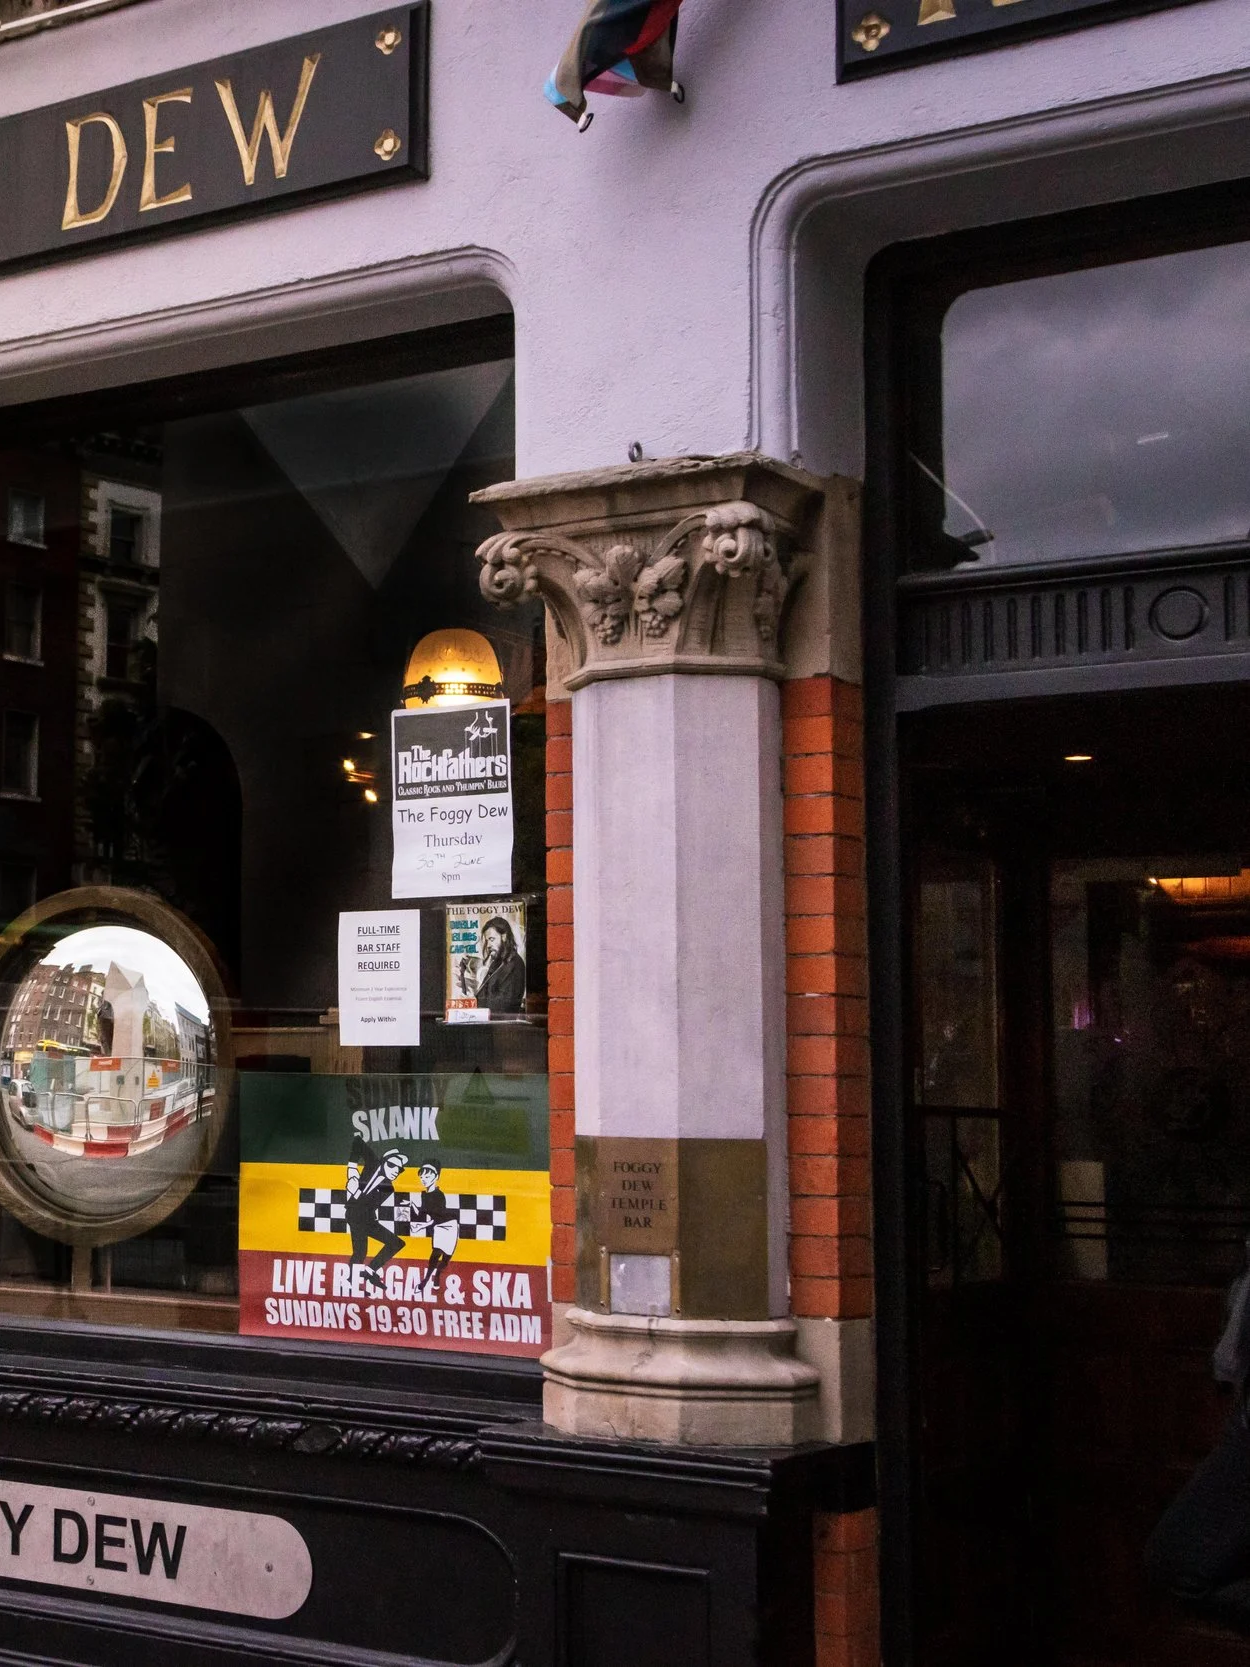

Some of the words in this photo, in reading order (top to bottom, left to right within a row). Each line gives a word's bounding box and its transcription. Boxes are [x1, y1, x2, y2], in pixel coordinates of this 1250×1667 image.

[60, 52, 321, 231] DEW
[411, 745, 431, 762] The
[397, 808, 425, 823] The
[430, 806, 473, 825] Foggy
[478, 803, 508, 819] Dew
[423, 832, 483, 848] Thursday
[441, 872, 461, 883] 8pm
[446, 907, 465, 916] THE
[467, 906, 499, 915] FOGGY
[502, 905, 523, 914] DEW
[357, 925, 400, 935] FULL-TIME
[357, 944, 374, 952] BAR
[376, 943, 401, 952] STAFF
[357, 961, 400, 971] REQUIRED
[351, 1105, 440, 1143] SKANK
[613, 1161, 662, 1174] FOGGY
[621, 1179, 654, 1192] DEW
[610, 1198, 667, 1211] TEMPLE
[623, 1216, 653, 1229] BAR
[272, 1259, 326, 1296] LIVE
[444, 1273, 466, 1305] &
[472, 1269, 533, 1309] SKA
[264, 1297, 362, 1331] SUNDAYS
[365, 1304, 427, 1336] 19.30
[432, 1309, 484, 1340] FREE
[488, 1312, 542, 1344] ADM
[53, 1508, 187, 1580] DEW
